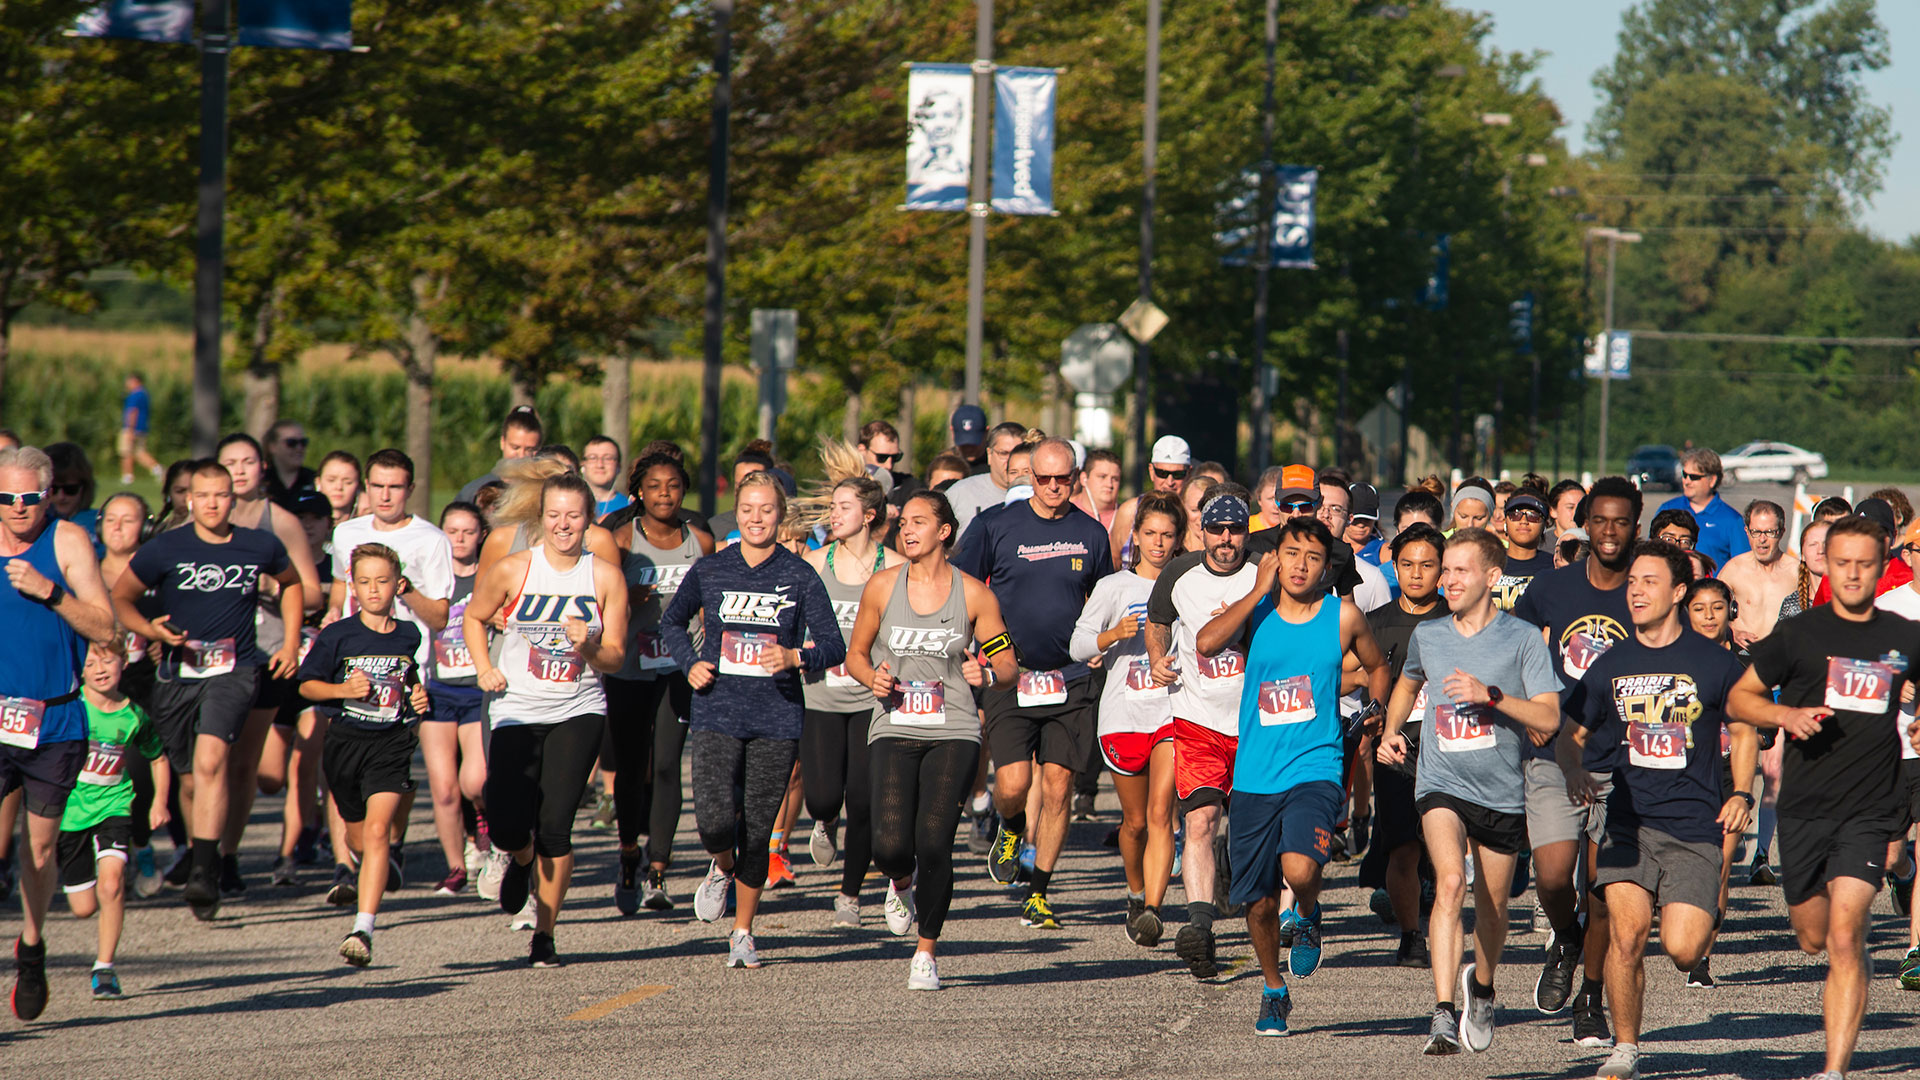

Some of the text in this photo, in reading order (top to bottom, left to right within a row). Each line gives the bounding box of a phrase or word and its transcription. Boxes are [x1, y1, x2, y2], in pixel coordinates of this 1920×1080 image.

[1276, 182, 1311, 247] UIS
[1071, 557, 1083, 571] 16
[516, 593, 597, 623] UIS
[720, 592, 780, 618] UIS
[651, 639, 669, 657] 18
[888, 628, 946, 652] UIS
[195, 649, 224, 667] 165
[348, 657, 399, 667] PRAIRIE
[734, 643, 763, 663] 181
[541, 660, 571, 681] 182
[1209, 655, 1240, 677] 152
[1028, 675, 1055, 694] 131
[1134, 669, 1153, 689] 16
[1616, 676, 1674, 690] PRAIRIE
[1843, 671, 1878, 698] 179
[903, 691, 933, 713] 180
[1269, 688, 1302, 713] 194
[1619, 685, 1664, 697] STARS
[1623, 695, 1666, 723] 5K
[1641, 734, 1673, 756] 143
[87, 751, 120, 775] 177
